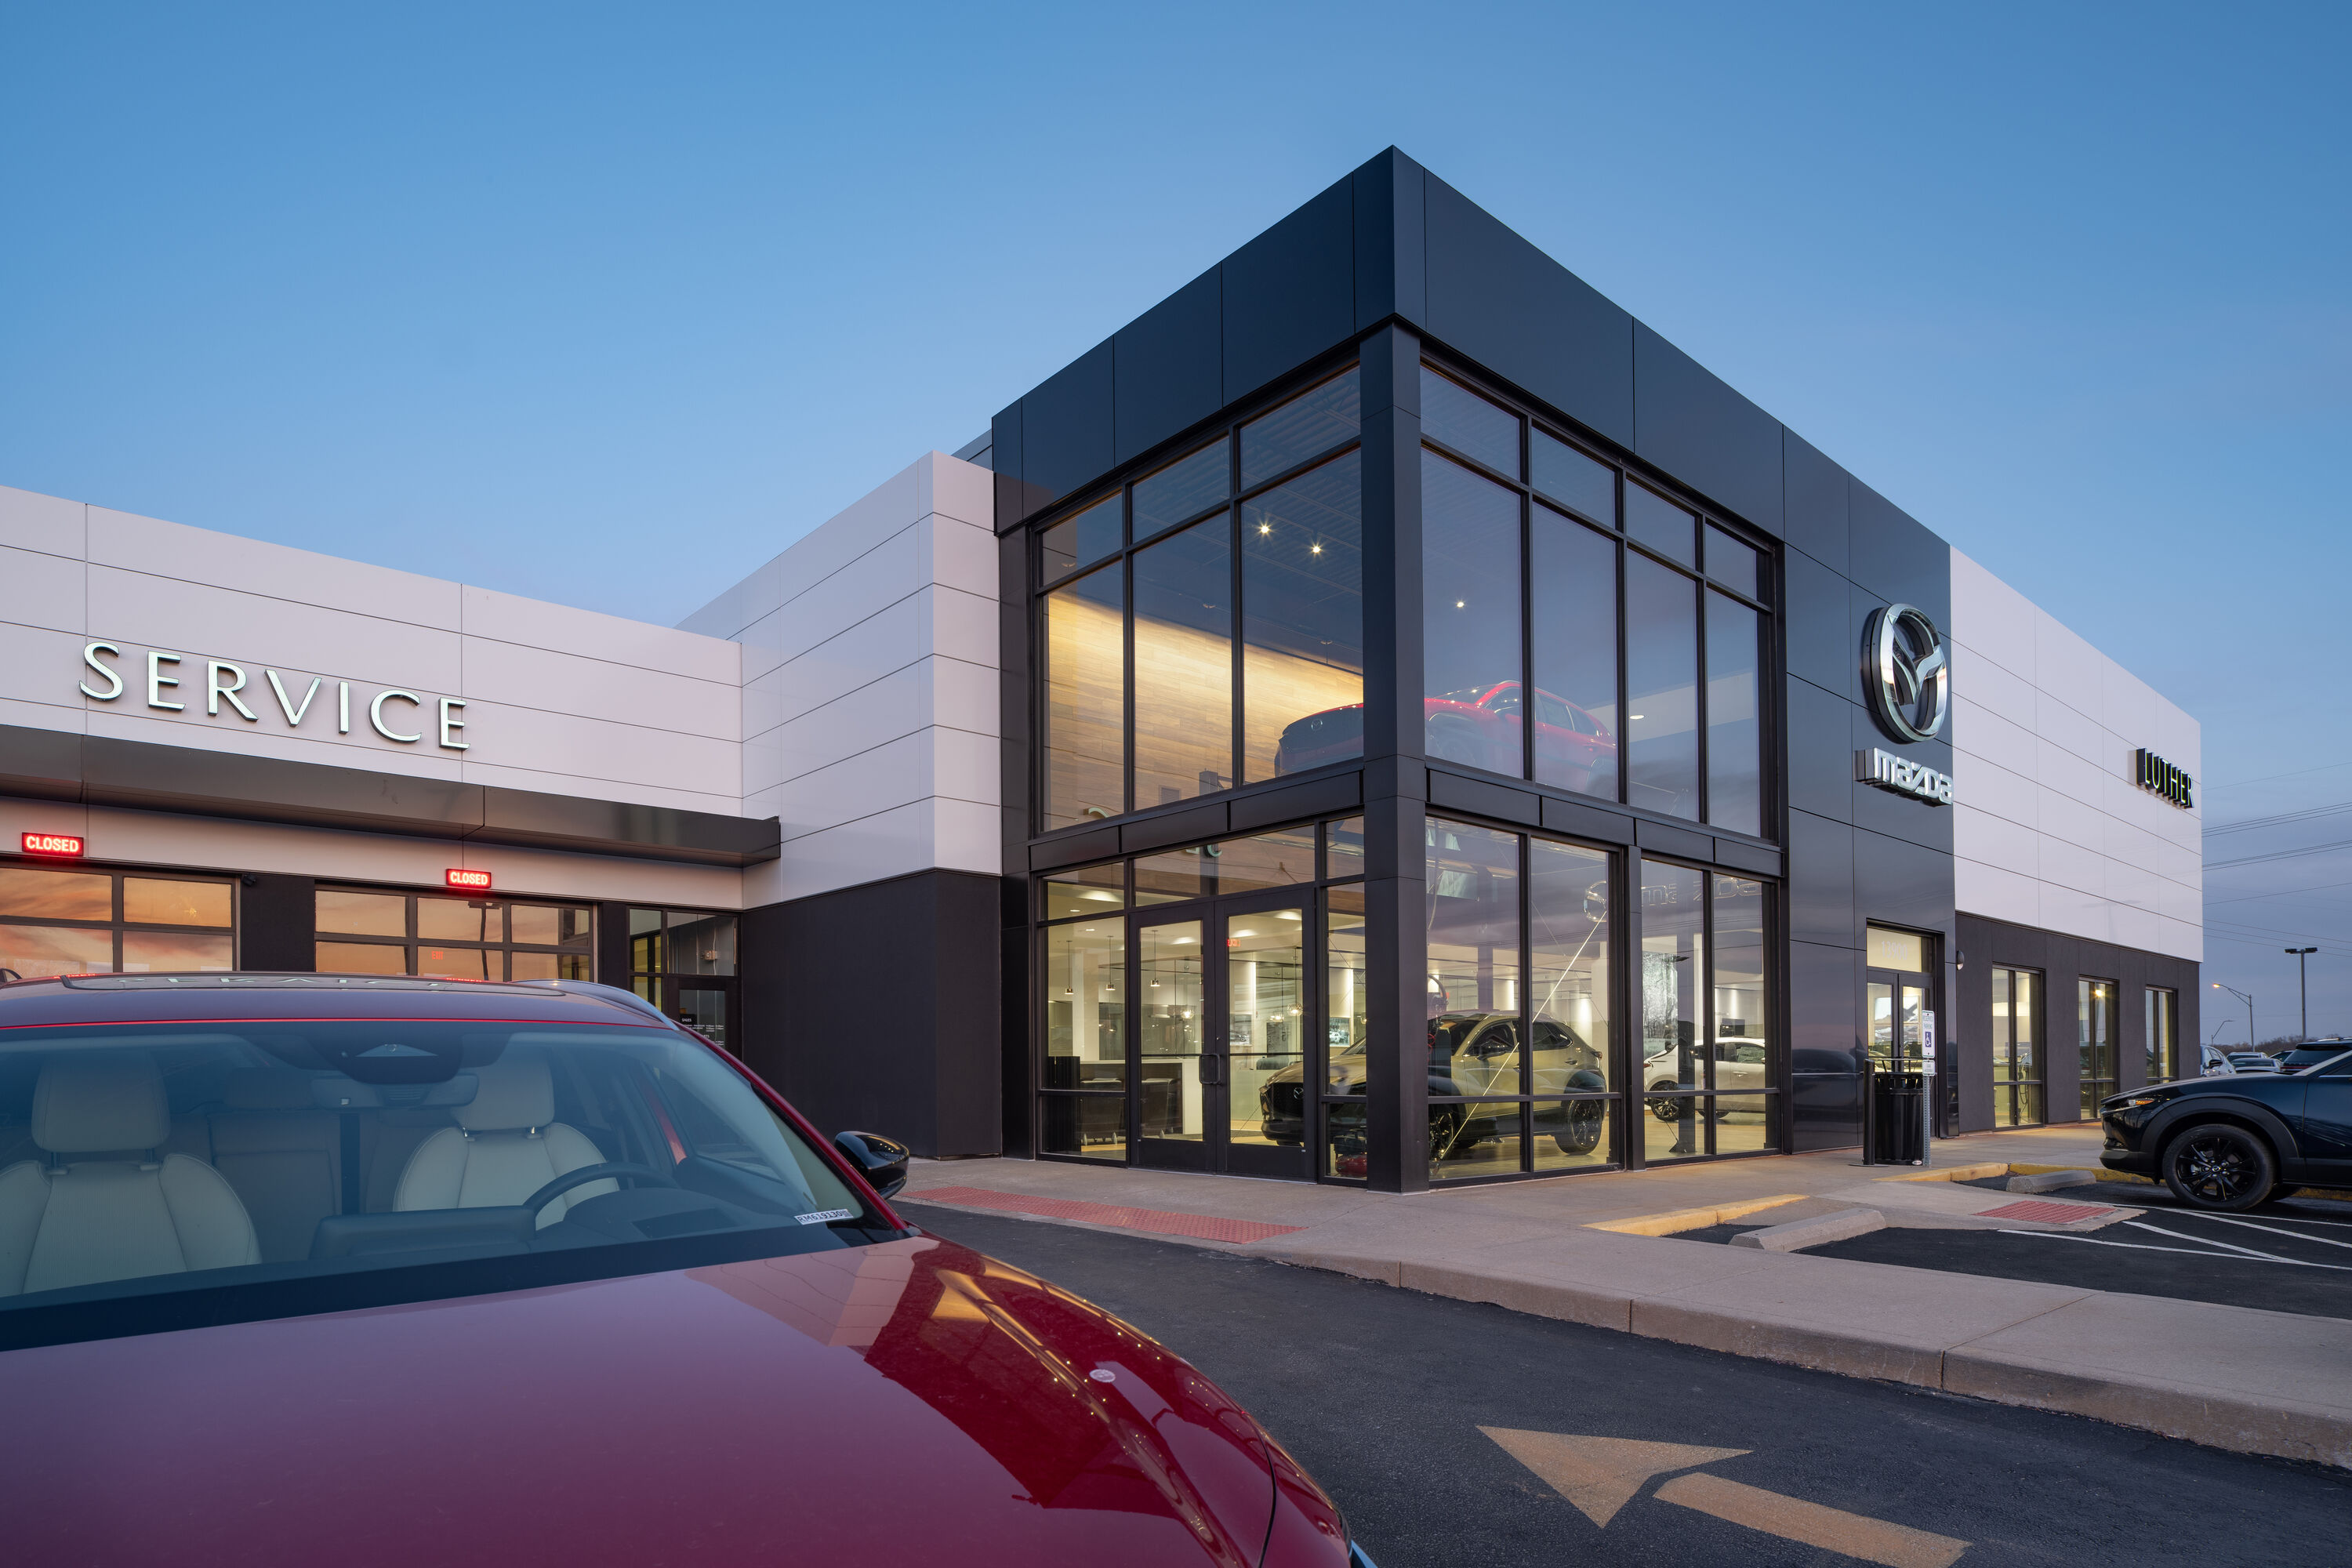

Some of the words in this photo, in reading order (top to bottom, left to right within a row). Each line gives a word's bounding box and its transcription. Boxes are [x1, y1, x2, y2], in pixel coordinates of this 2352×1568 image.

[78, 641, 470, 750] SERVICE
[2144, 747, 2194, 808] LUTHER
[26, 836, 79, 852] CLOSED
[450, 871, 488, 885] CLOSED
[431, 950, 445, 960] EXIT
[1881, 940, 1907, 960] 13900
